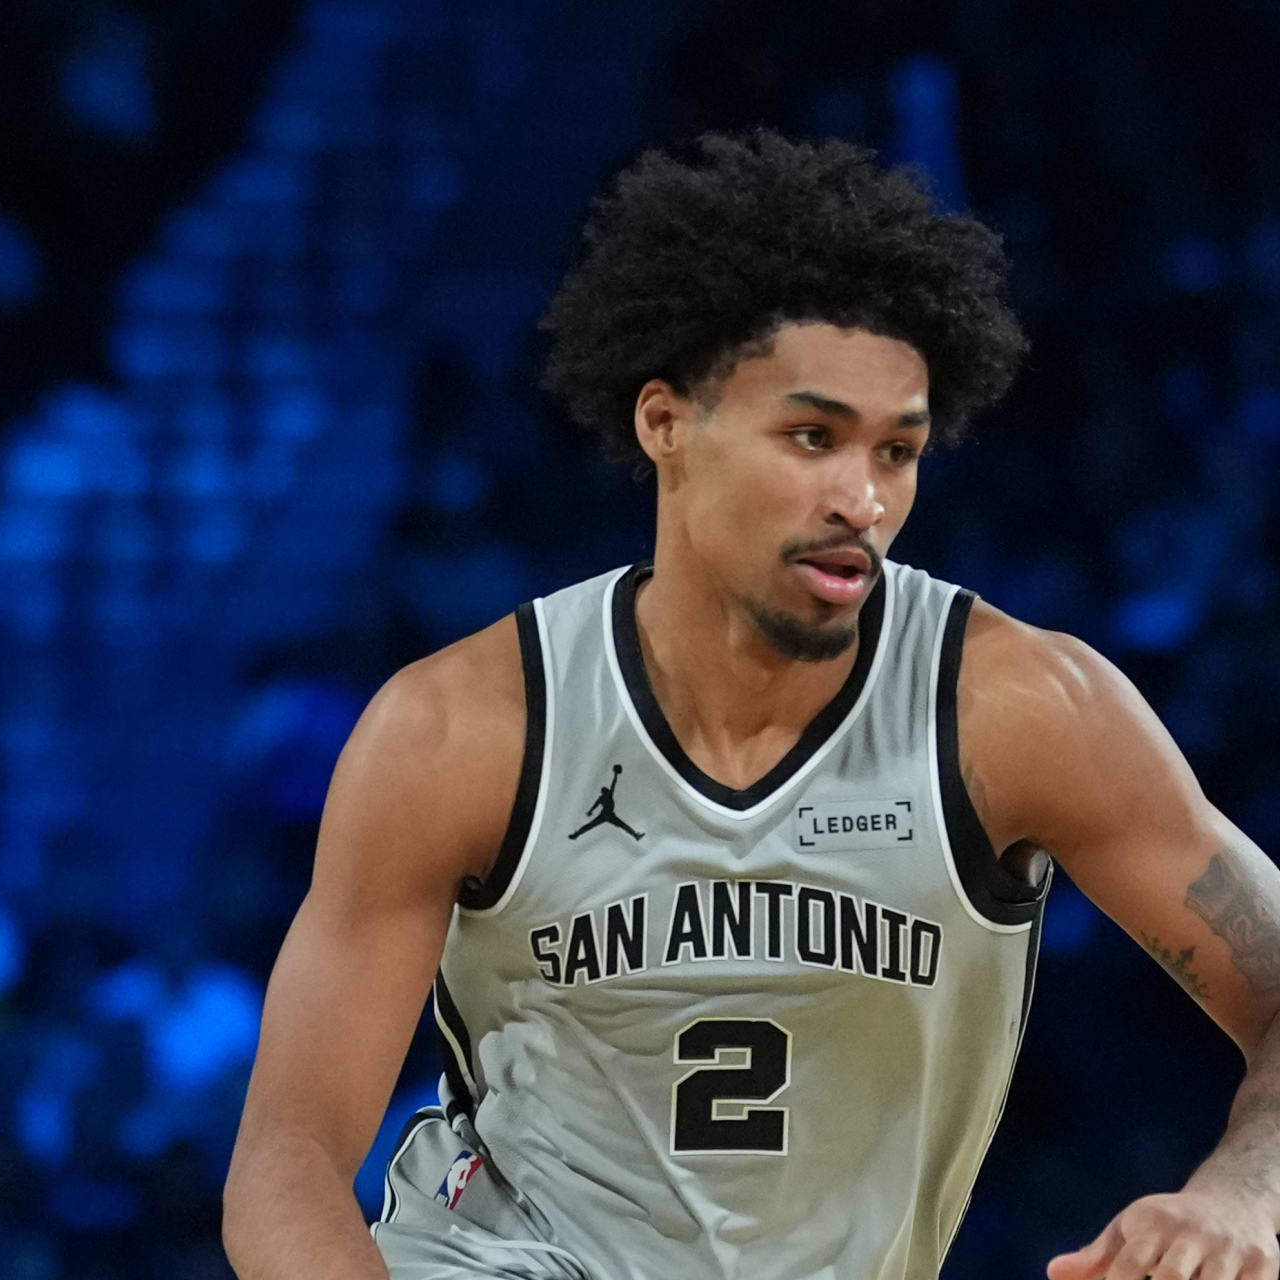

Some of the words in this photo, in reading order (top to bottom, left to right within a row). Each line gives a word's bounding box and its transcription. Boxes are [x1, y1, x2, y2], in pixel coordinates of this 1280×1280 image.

[813, 813, 897, 834] LEDGER
[529, 892, 648, 987] SAN
[661, 879, 943, 989] ANTONIO
[669, 1016, 793, 1157] 2
